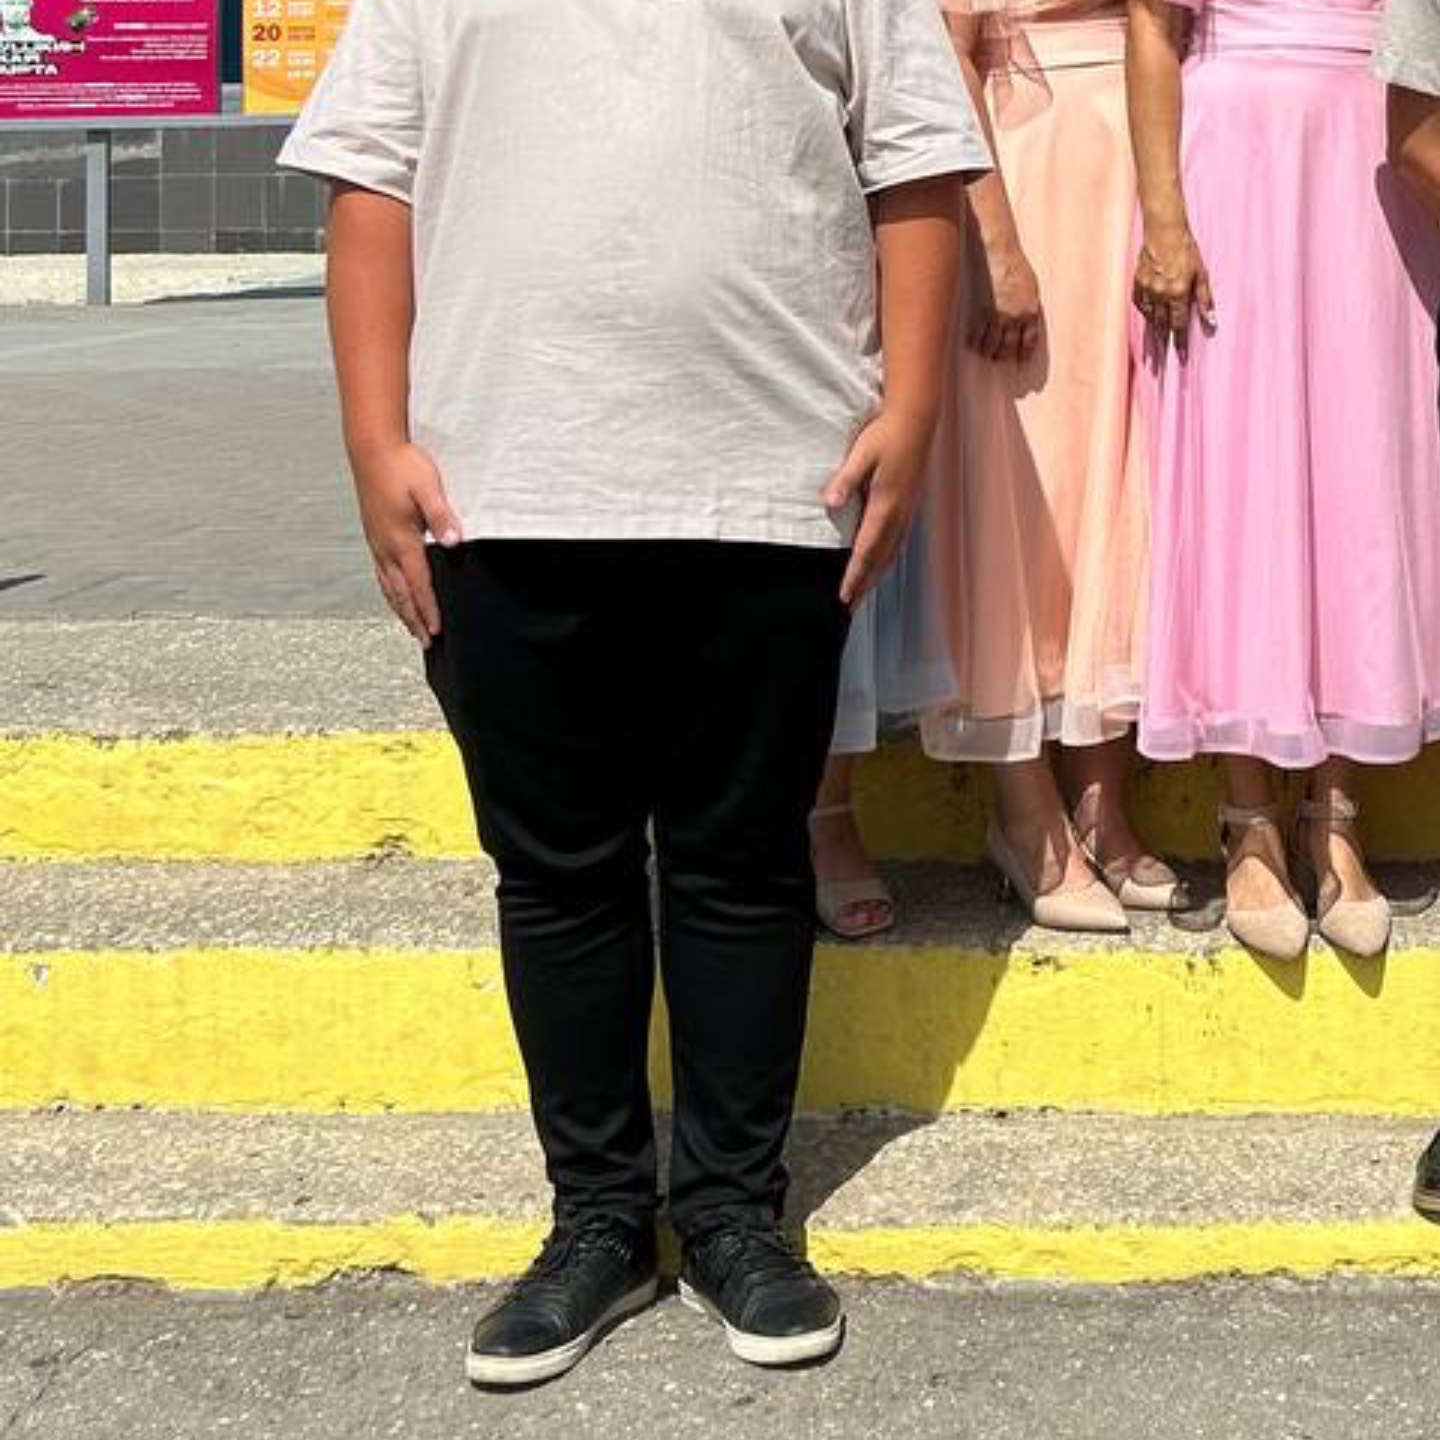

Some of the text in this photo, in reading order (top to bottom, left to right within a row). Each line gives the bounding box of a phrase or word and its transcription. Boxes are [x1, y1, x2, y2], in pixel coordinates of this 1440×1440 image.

[252, 0, 282, 18] 12
[252, 23, 282, 42] 20
[252, 48, 282, 67] 22
